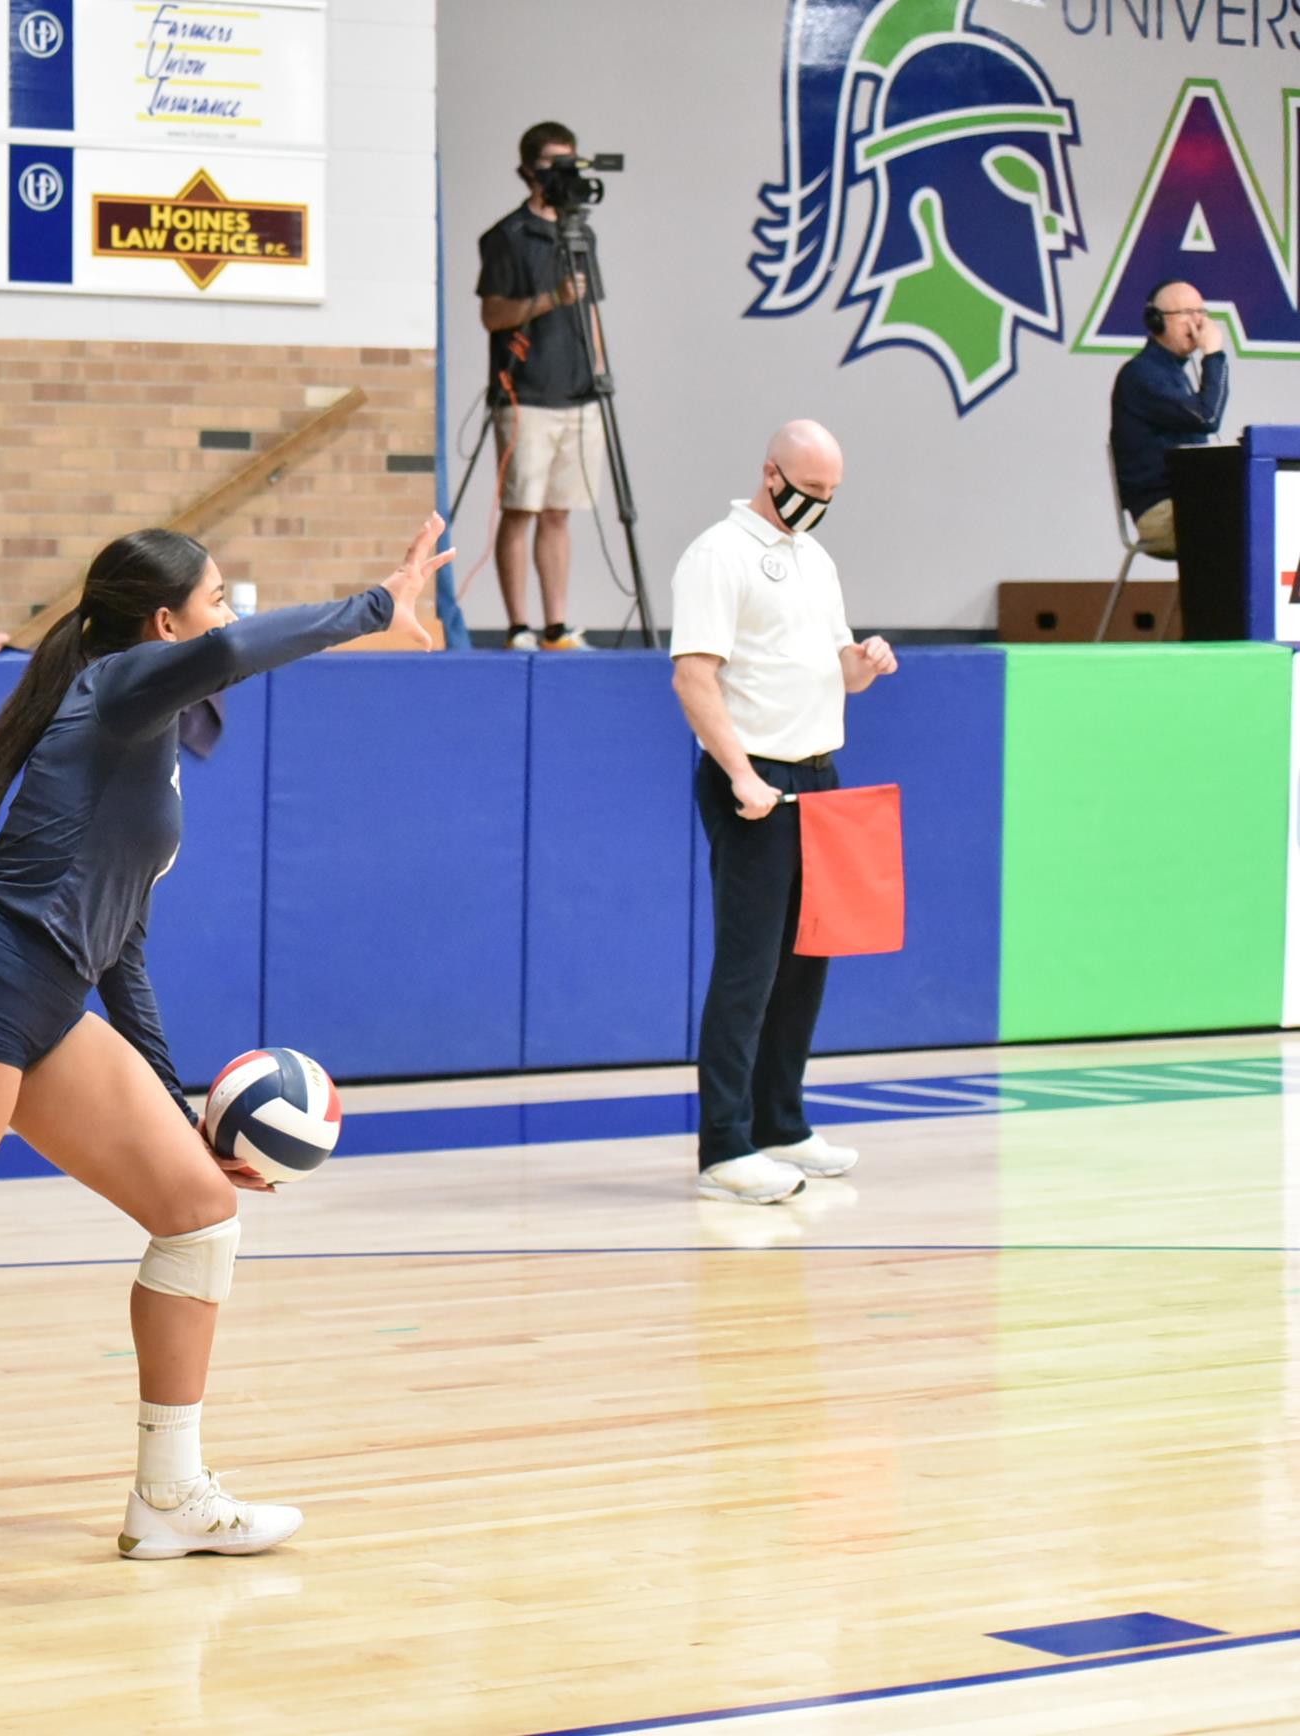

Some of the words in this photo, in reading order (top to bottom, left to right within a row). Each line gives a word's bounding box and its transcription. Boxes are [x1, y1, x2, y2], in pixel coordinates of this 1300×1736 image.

[148, 4, 233, 42] Farmers
[145, 40, 207, 79] Union
[147, 76, 242, 118] Insurance
[110, 224, 168, 250] LAW
[150, 204, 252, 232] HOINES
